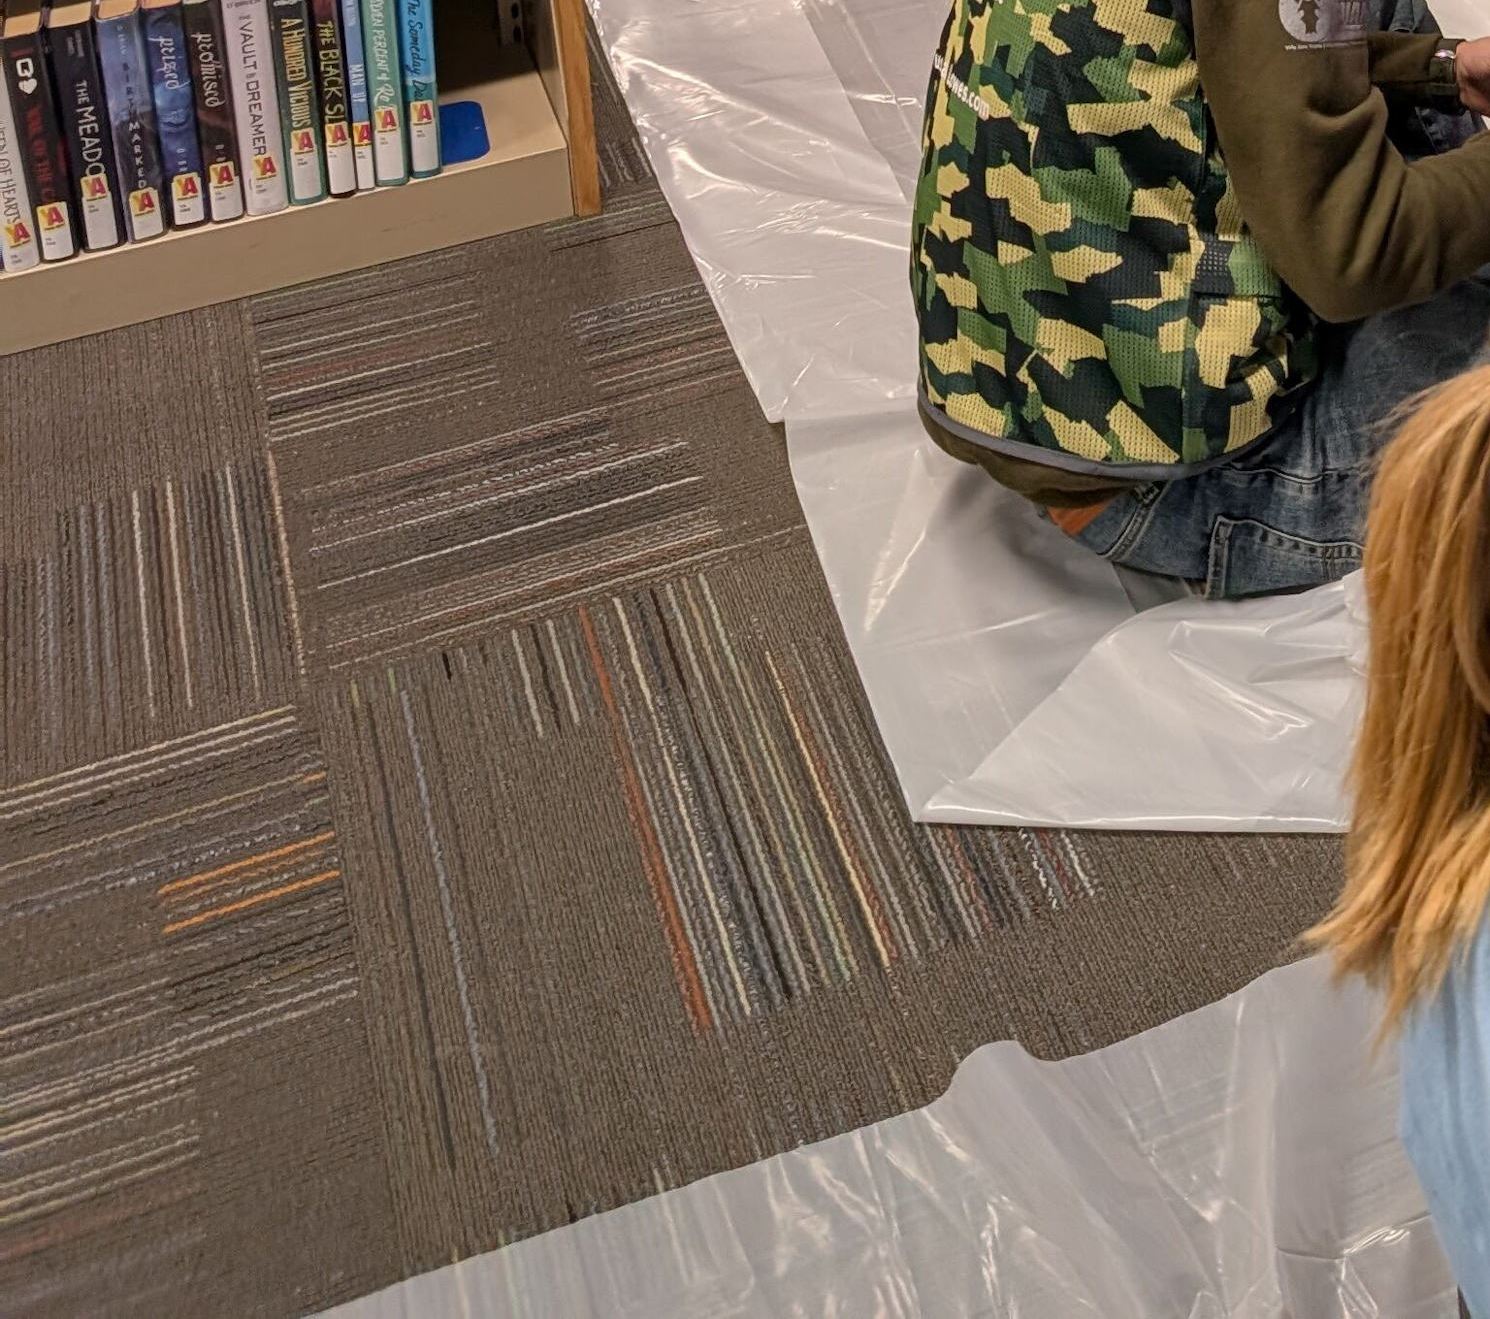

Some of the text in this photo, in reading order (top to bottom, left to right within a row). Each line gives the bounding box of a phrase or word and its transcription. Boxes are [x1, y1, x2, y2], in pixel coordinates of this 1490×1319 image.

[239, 21, 257, 70] VAULT
[281, 18, 303, 29] A
[316, 20, 336, 46] THE
[404, 20, 428, 76] Someday
[282, 29, 307, 82] HUNDRED
[319, 48, 343, 99] BLACK
[76, 80, 89, 104] THE
[287, 81, 312, 128] VICIOUS
[246, 80, 267, 156] DREAMER
